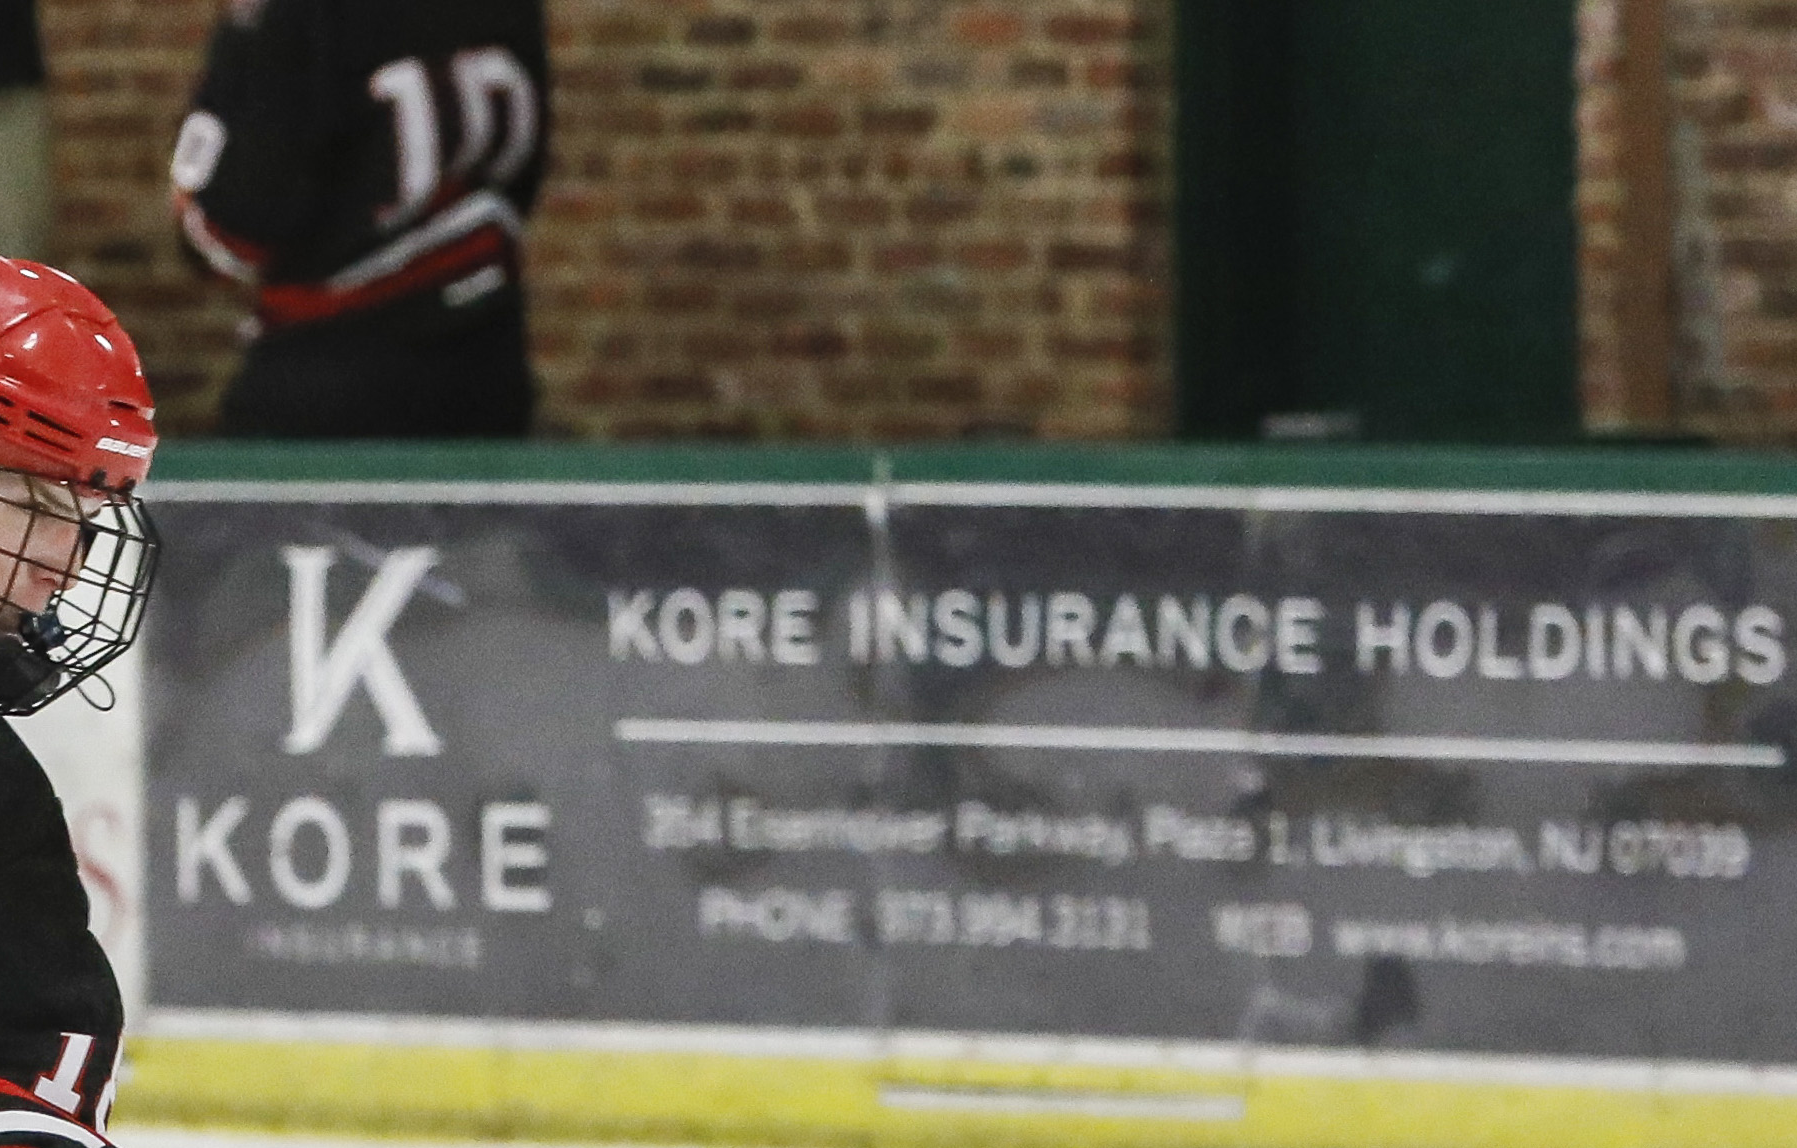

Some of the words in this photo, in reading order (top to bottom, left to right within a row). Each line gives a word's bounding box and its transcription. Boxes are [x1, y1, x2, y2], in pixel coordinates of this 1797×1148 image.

[608, 587, 821, 666] KORE
[848, 588, 1325, 676] INSURANCE
[1354, 598, 1788, 684] HOLDINGS
[172, 797, 555, 913] KORE
